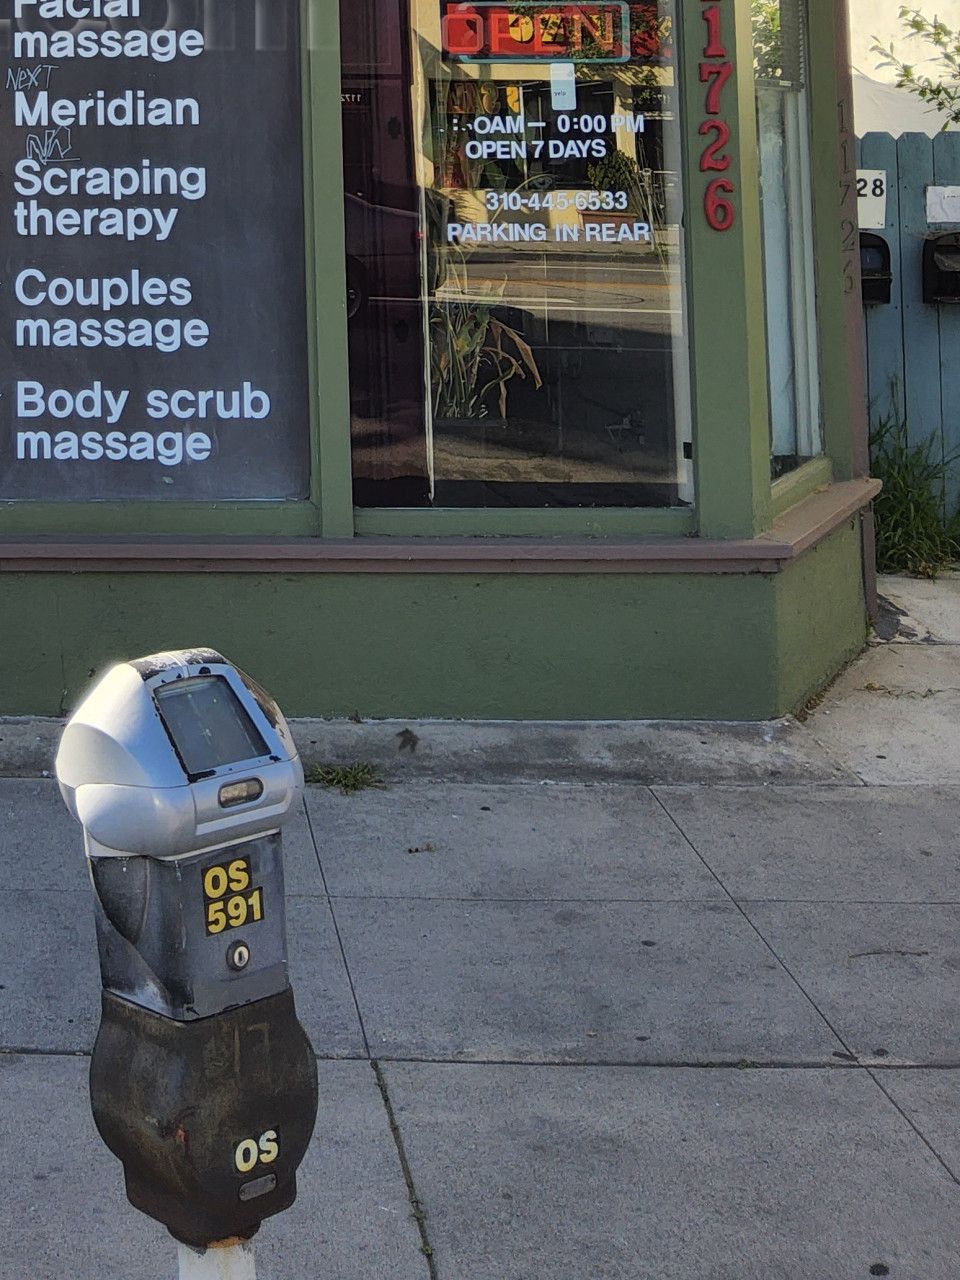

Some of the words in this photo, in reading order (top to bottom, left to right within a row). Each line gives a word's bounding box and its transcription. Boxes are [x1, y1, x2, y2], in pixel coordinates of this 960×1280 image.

[14, 29, 204, 62] massage
[442, 13, 613, 53] OPEN
[14, 90, 200, 126] Meridian
[611, 115, 644, 133] PM
[466, 141, 527, 159] OPEN
[532, 141, 544, 158] 7
[549, 140, 606, 158] DAYS
[14, 159, 207, 200] Scraping
[486, 191, 628, 211] 310-445-6533
[14, 200, 178, 241] therapy
[448, 224, 547, 242] PARKING
[556, 224, 578, 241] IN
[586, 223, 650, 241] REAR
[15, 269, 192, 311] Couples
[16, 318, 209, 352] massage
[17, 381, 129, 423] Body
[146, 382, 270, 418] scrub
[17, 430, 211, 465] massage
[208, 890, 261, 934] 591
